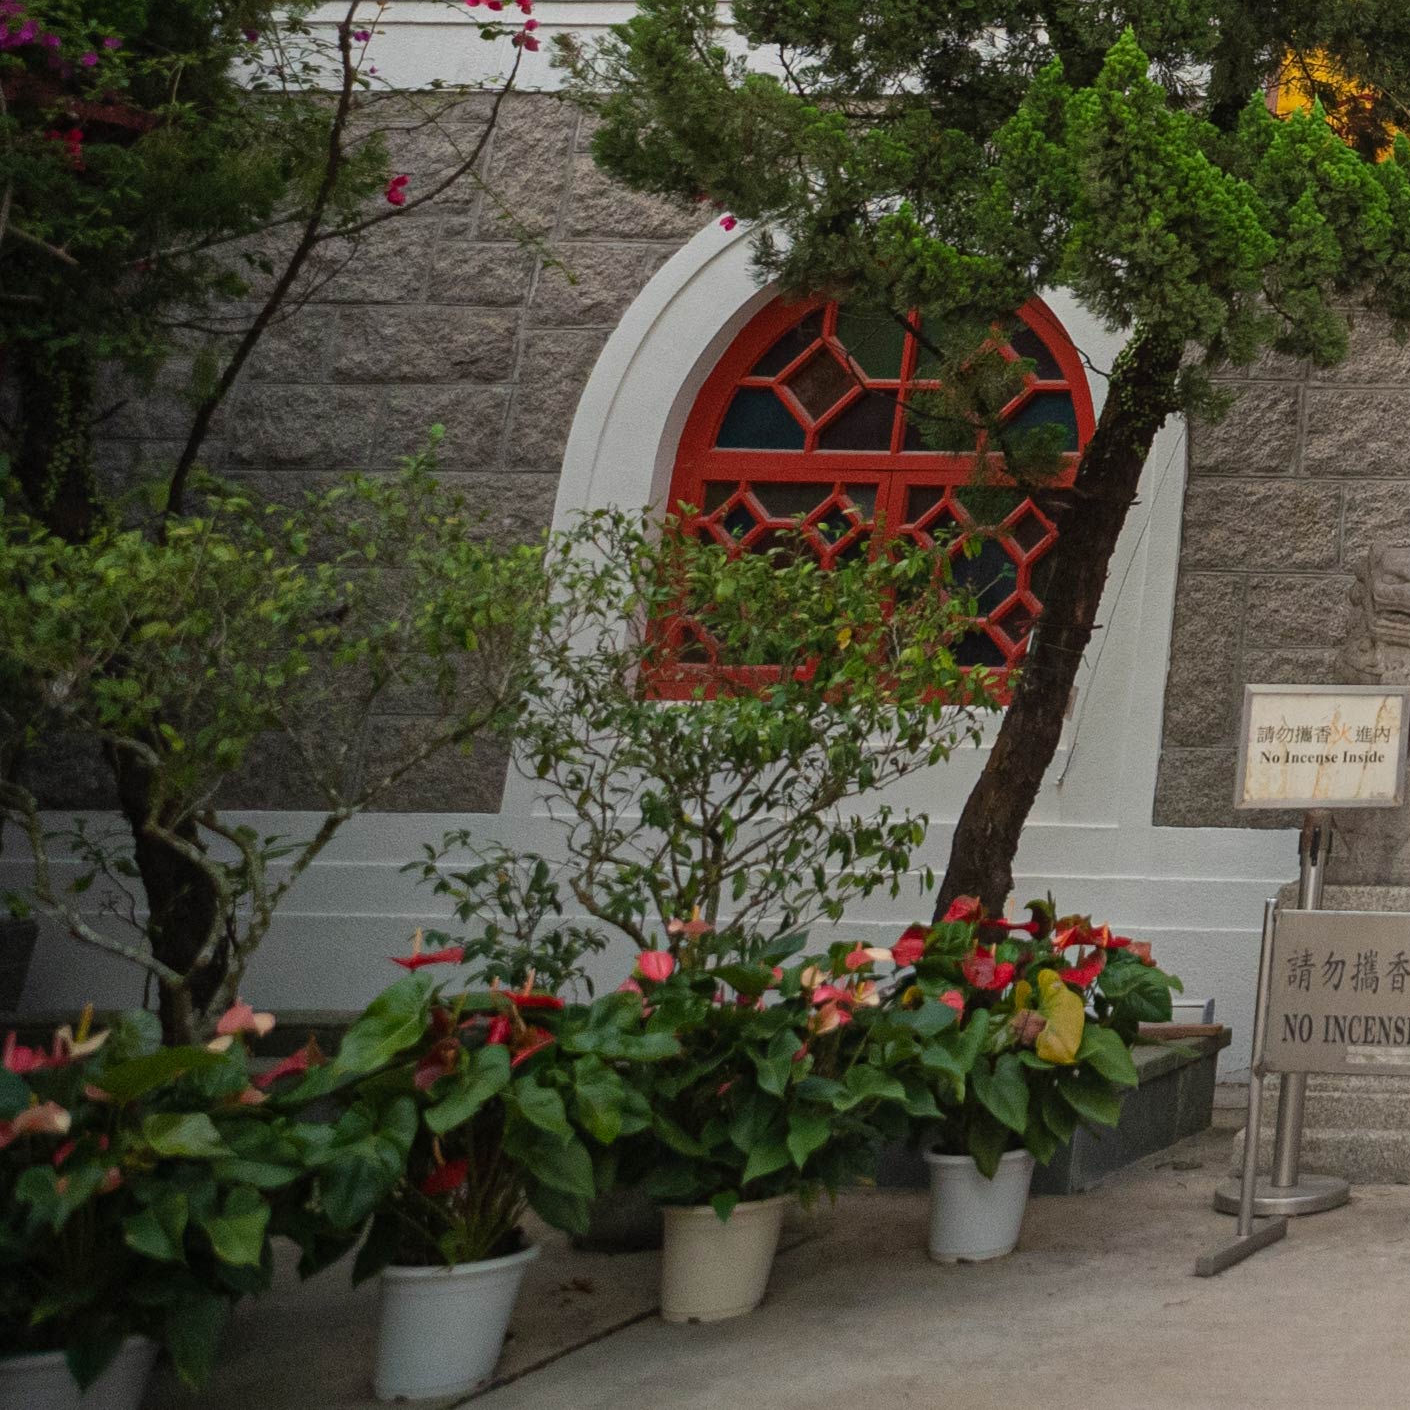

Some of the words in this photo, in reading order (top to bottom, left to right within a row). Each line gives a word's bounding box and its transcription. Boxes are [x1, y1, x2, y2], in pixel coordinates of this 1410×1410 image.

[1260, 752, 1280, 764] No
[1285, 751, 1338, 764] Incense
[1343, 751, 1385, 764] Inside
[1282, 1013, 1313, 1043] NO
